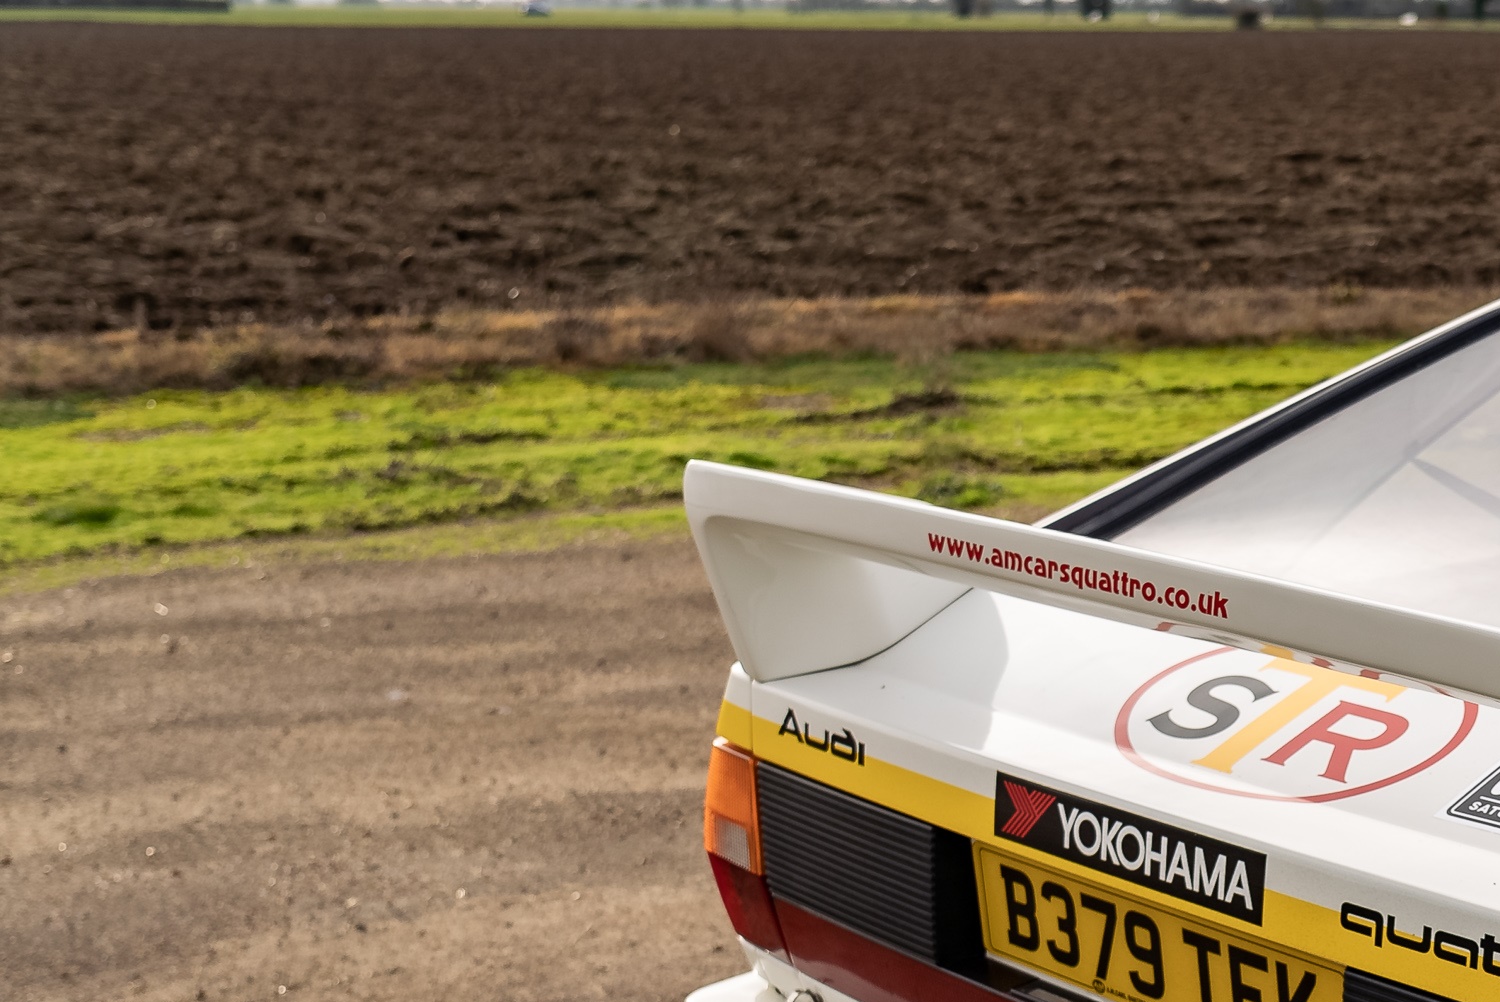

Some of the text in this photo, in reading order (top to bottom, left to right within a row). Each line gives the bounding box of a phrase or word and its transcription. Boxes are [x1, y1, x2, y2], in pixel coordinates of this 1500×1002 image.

[928, 533, 1229, 619] www.amcarsquattro.co.uk
[778, 707, 865, 766] Audi
[1146, 657, 1408, 784] STR
[1057, 803, 1253, 910] YOKOHAMA
[1000, 864, 1166, 1000] B379
